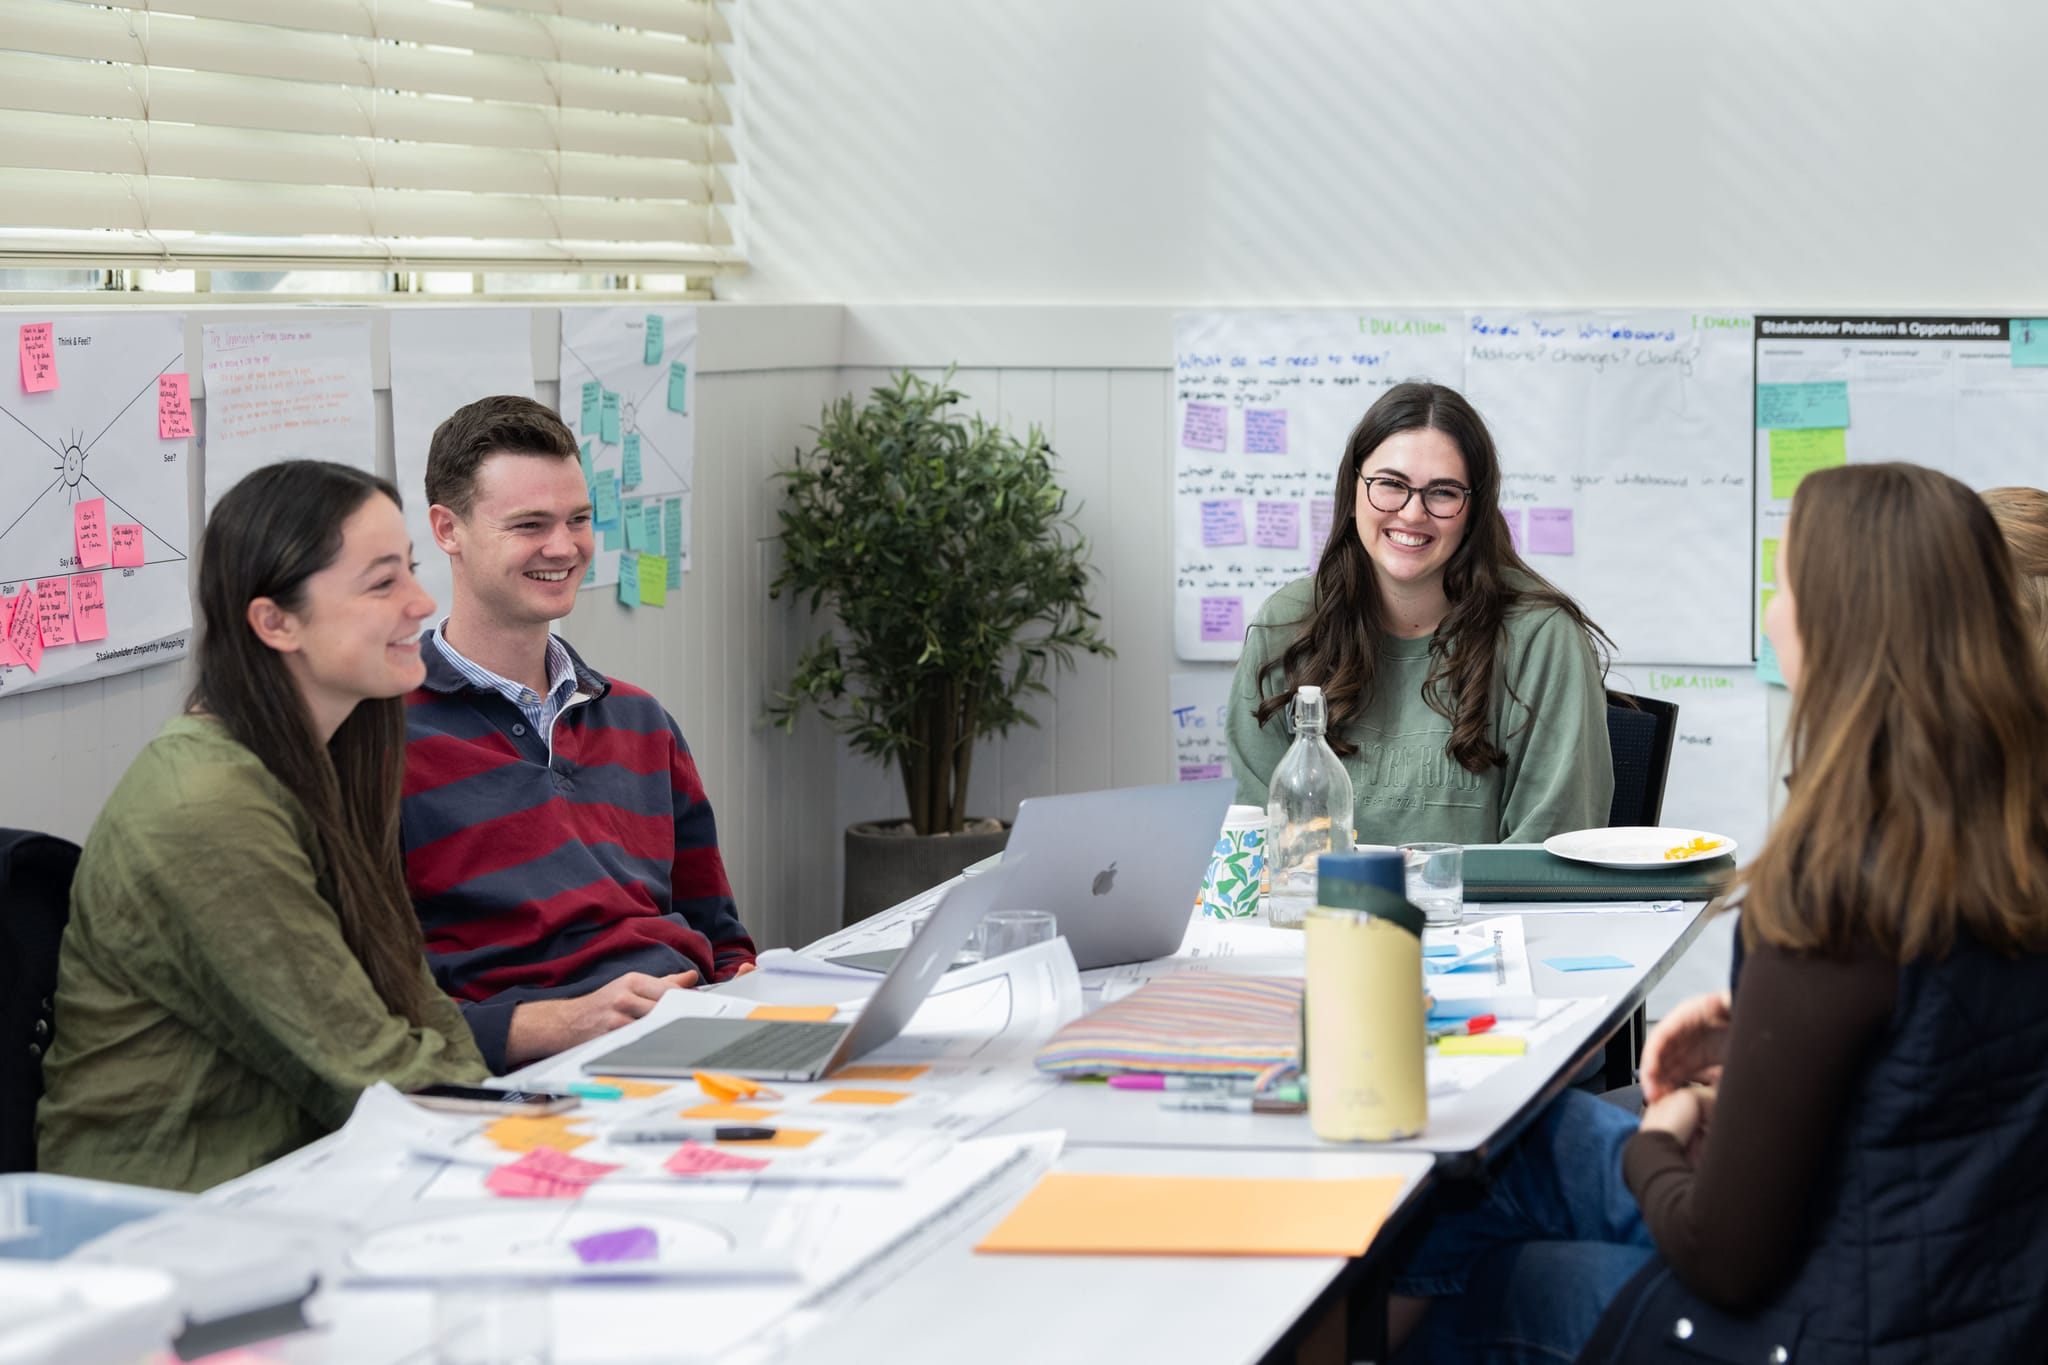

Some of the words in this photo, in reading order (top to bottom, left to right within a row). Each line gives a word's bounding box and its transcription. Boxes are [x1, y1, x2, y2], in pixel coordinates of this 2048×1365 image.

[1358, 315, 1448, 336] EDUCATION
[1471, 315, 1519, 336] Review
[1532, 319, 1565, 338] Your
[1577, 320, 1675, 342] Whiteboard
[1761, 320, 1840, 336] Stakeholder
[1841, 321, 1897, 337] Problem
[1898, 321, 1908, 336] &
[1908, 321, 2001, 339] Opportunities
[58, 337, 72, 346] Think
[78, 336, 91, 346] Feel?
[1178, 353, 1222, 369] What
[1230, 355, 1248, 367] do
[1258, 356, 1277, 367] we
[1285, 354, 1320, 366] need
[1328, 354, 1342, 365] to
[1551, 349, 1631, 373] Changes?
[1635, 349, 1702, 377] Clarify?
[163, 453, 177, 463] See?
[1569, 471, 1605, 493] your
[59, 557, 69, 568] Say
[122, 568, 135, 577] Gain
[2, 585, 15, 594] Pain
[95, 648, 134, 662] Stakeholder
[133, 643, 159, 656] Empathy
[160, 636, 185, 650] Mapping
[1172, 704, 1206, 728] The
